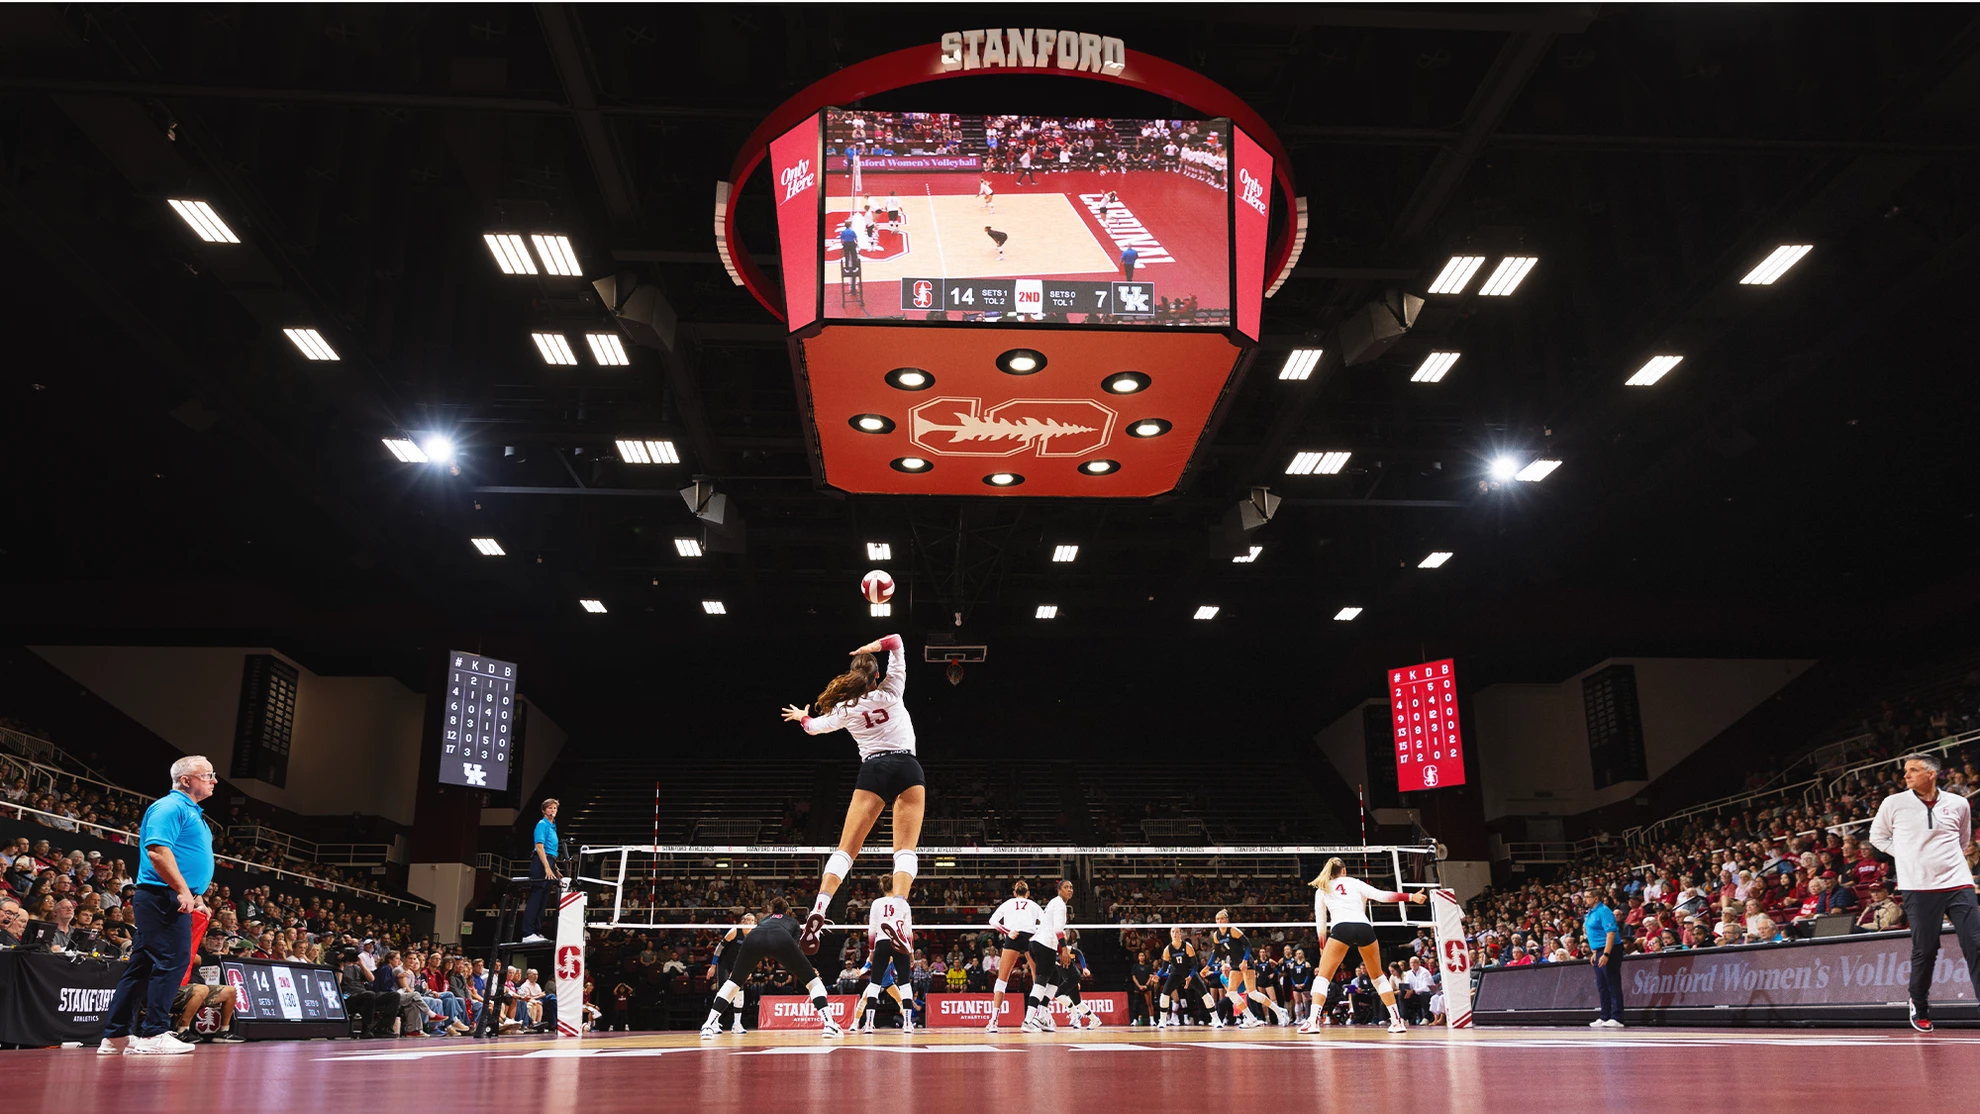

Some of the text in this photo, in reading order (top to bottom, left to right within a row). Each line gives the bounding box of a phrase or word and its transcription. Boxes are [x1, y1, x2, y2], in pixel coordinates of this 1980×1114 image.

[941, 27, 1125, 76] STANFORD
[780, 158, 809, 186] Only
[843, 158, 976, 168] Snford Women's Volleyball
[780, 172, 815, 206] Here
[1239, 167, 1263, 198] Only
[1237, 186, 1266, 216] Here
[950, 287, 974, 305] 14
[981, 289, 1007, 298] SETS 1
[984, 297, 1005, 305] TOL 2
[1018, 291, 1040, 303] 2ND
[1050, 291, 1070, 299] SETS
[1095, 291, 1107, 308] 7
[455, 656, 512, 677] # K D B
[1393, 664, 1449, 683] # K D B
[454, 673, 509, 691] 1 2 1 1
[1395, 679, 1451, 697] 2 1 5 0
[452, 687, 510, 705] 4 1 8 0
[1396, 693, 1452, 710] 4 0 4 0
[451, 701, 508, 719] 6 0 4 0
[1397, 714, 1404, 724] 9
[1413, 712, 1421, 721] 0
[1446, 707, 1453, 716] 0
[449, 715, 507, 733] 8 3 1 0
[1431, 723, 1438, 732] 3
[1447, 720, 1455, 730] 0
[447, 730, 506, 748] 12 0 5 0
[1416, 740, 1423, 749] 2
[1434, 737, 1438, 746] 1
[1448, 734, 1456, 744] 2
[445, 744, 505, 762] 17 3 3 0
[1417, 753, 1424, 762] 2
[1433, 750, 1441, 760] 0
[1450, 748, 1457, 758] 2
[1335, 884, 1347, 895] 4
[1015, 901, 1028, 910] 17
[1632, 949, 1971, 994] Stanford Women's Volleba
[252, 970, 269, 992] 14
[301, 974, 310, 993] 7
[774, 1002, 844, 1016] STANFRD
[941, 1000, 1009, 1014] STANFOD
